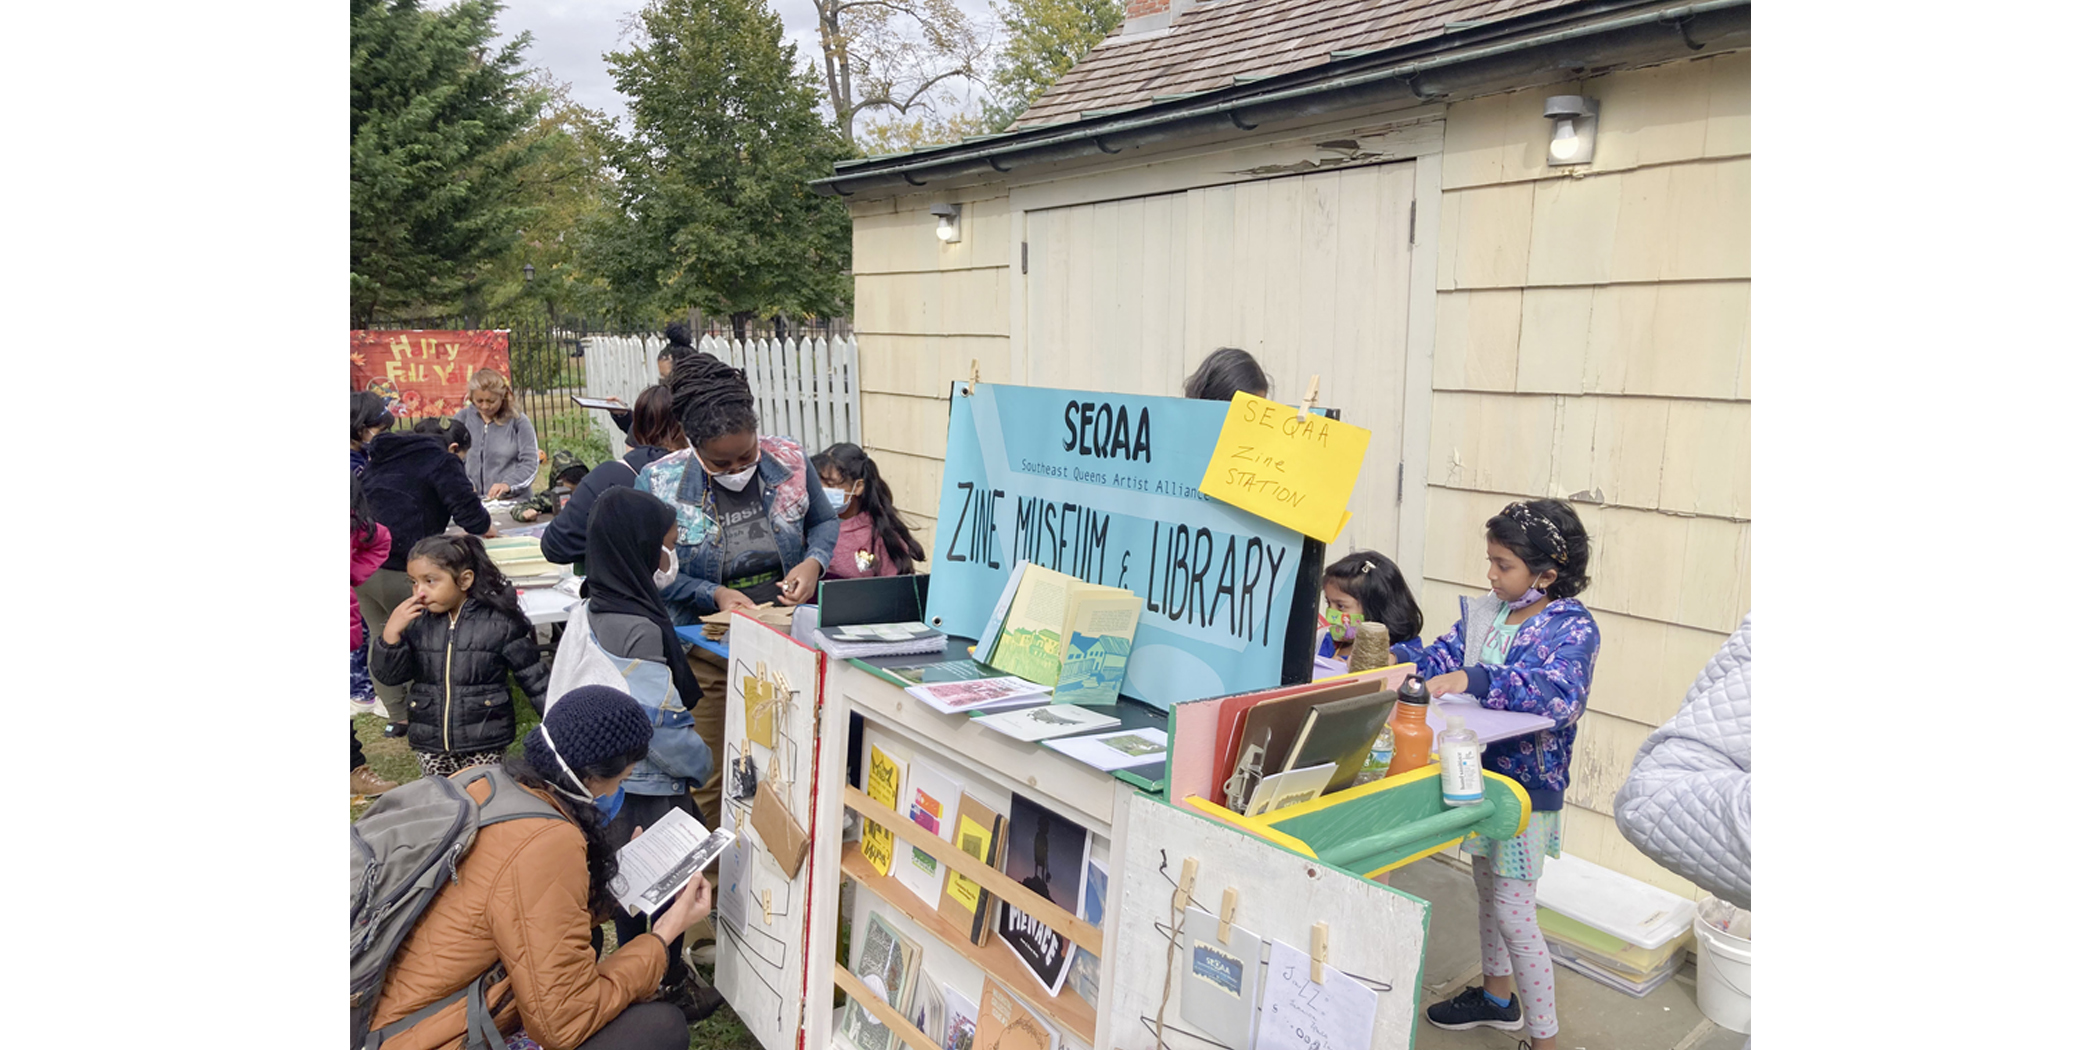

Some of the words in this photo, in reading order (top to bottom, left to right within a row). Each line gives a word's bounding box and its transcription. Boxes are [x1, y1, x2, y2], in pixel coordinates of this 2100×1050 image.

[1062, 400, 1151, 463] SEQAA
[1244, 400, 1329, 448] SEQAA
[1021, 458, 1068, 478] Southeast
[1073, 466, 1107, 485] Queens
[1113, 473, 1149, 492] Artist
[1231, 446, 1285, 473] Zine
[1225, 468, 1306, 508] STATION
[946, 482, 1005, 570] ZINE
[1013, 496, 1110, 585] MUSEUM
[1147, 520, 1286, 647] LIBRARY
[1008, 904, 1060, 967] MENACE
